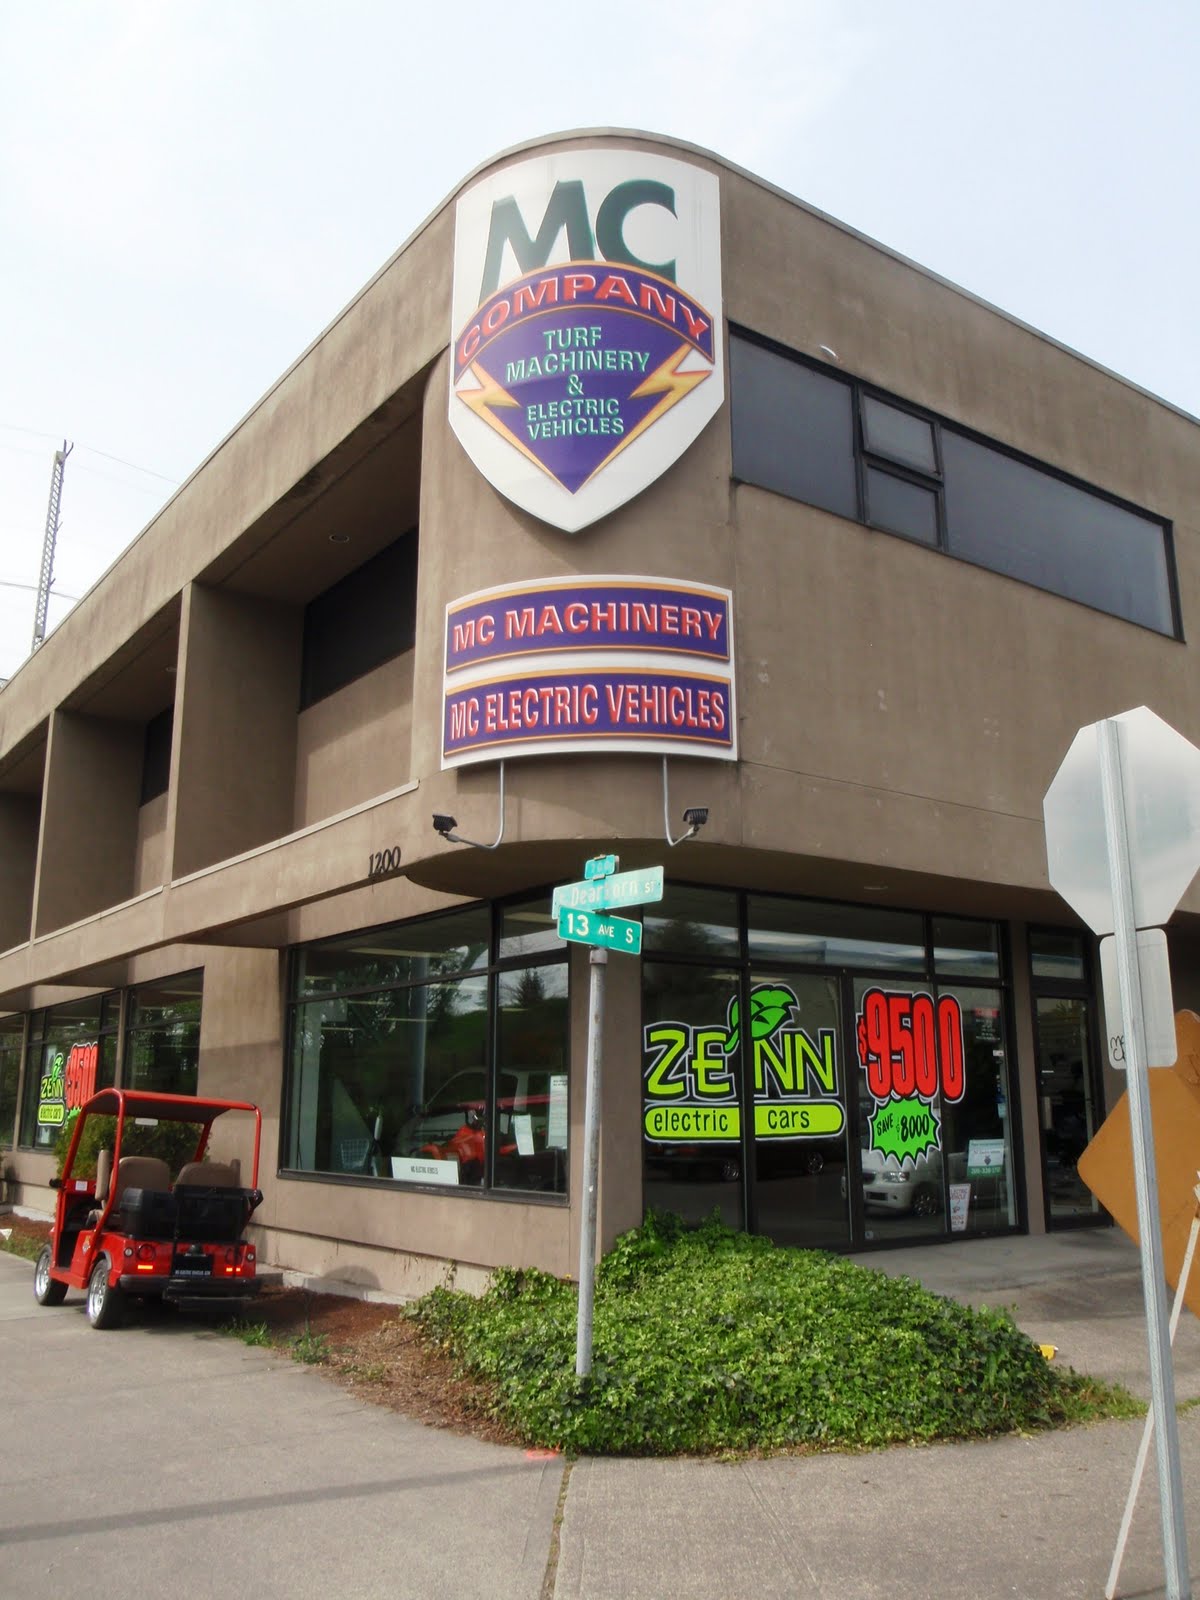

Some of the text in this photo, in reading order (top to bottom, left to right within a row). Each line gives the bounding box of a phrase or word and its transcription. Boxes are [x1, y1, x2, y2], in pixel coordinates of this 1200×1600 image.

[478, 179, 678, 308] MC
[458, 273, 710, 366] COMPANY
[542, 326, 602, 351] TURF
[506, 350, 650, 383] MACHINERY
[568, 374, 584, 395] &
[527, 399, 620, 423] ELECTRIC
[527, 417, 625, 440] VEHICLES
[452, 602, 723, 653] MC MACHINERY
[451, 684, 726, 740] MC ELECTRIC VEHICLES
[368, 846, 401, 878] 1200
[567, 913, 634, 944] 13 AVE S
[857, 990, 964, 1099] $9500
[646, 1026, 836, 1097] ZENN
[654, 1109, 811, 1132] electric cars
[876, 1113, 893, 1136] SAVE
